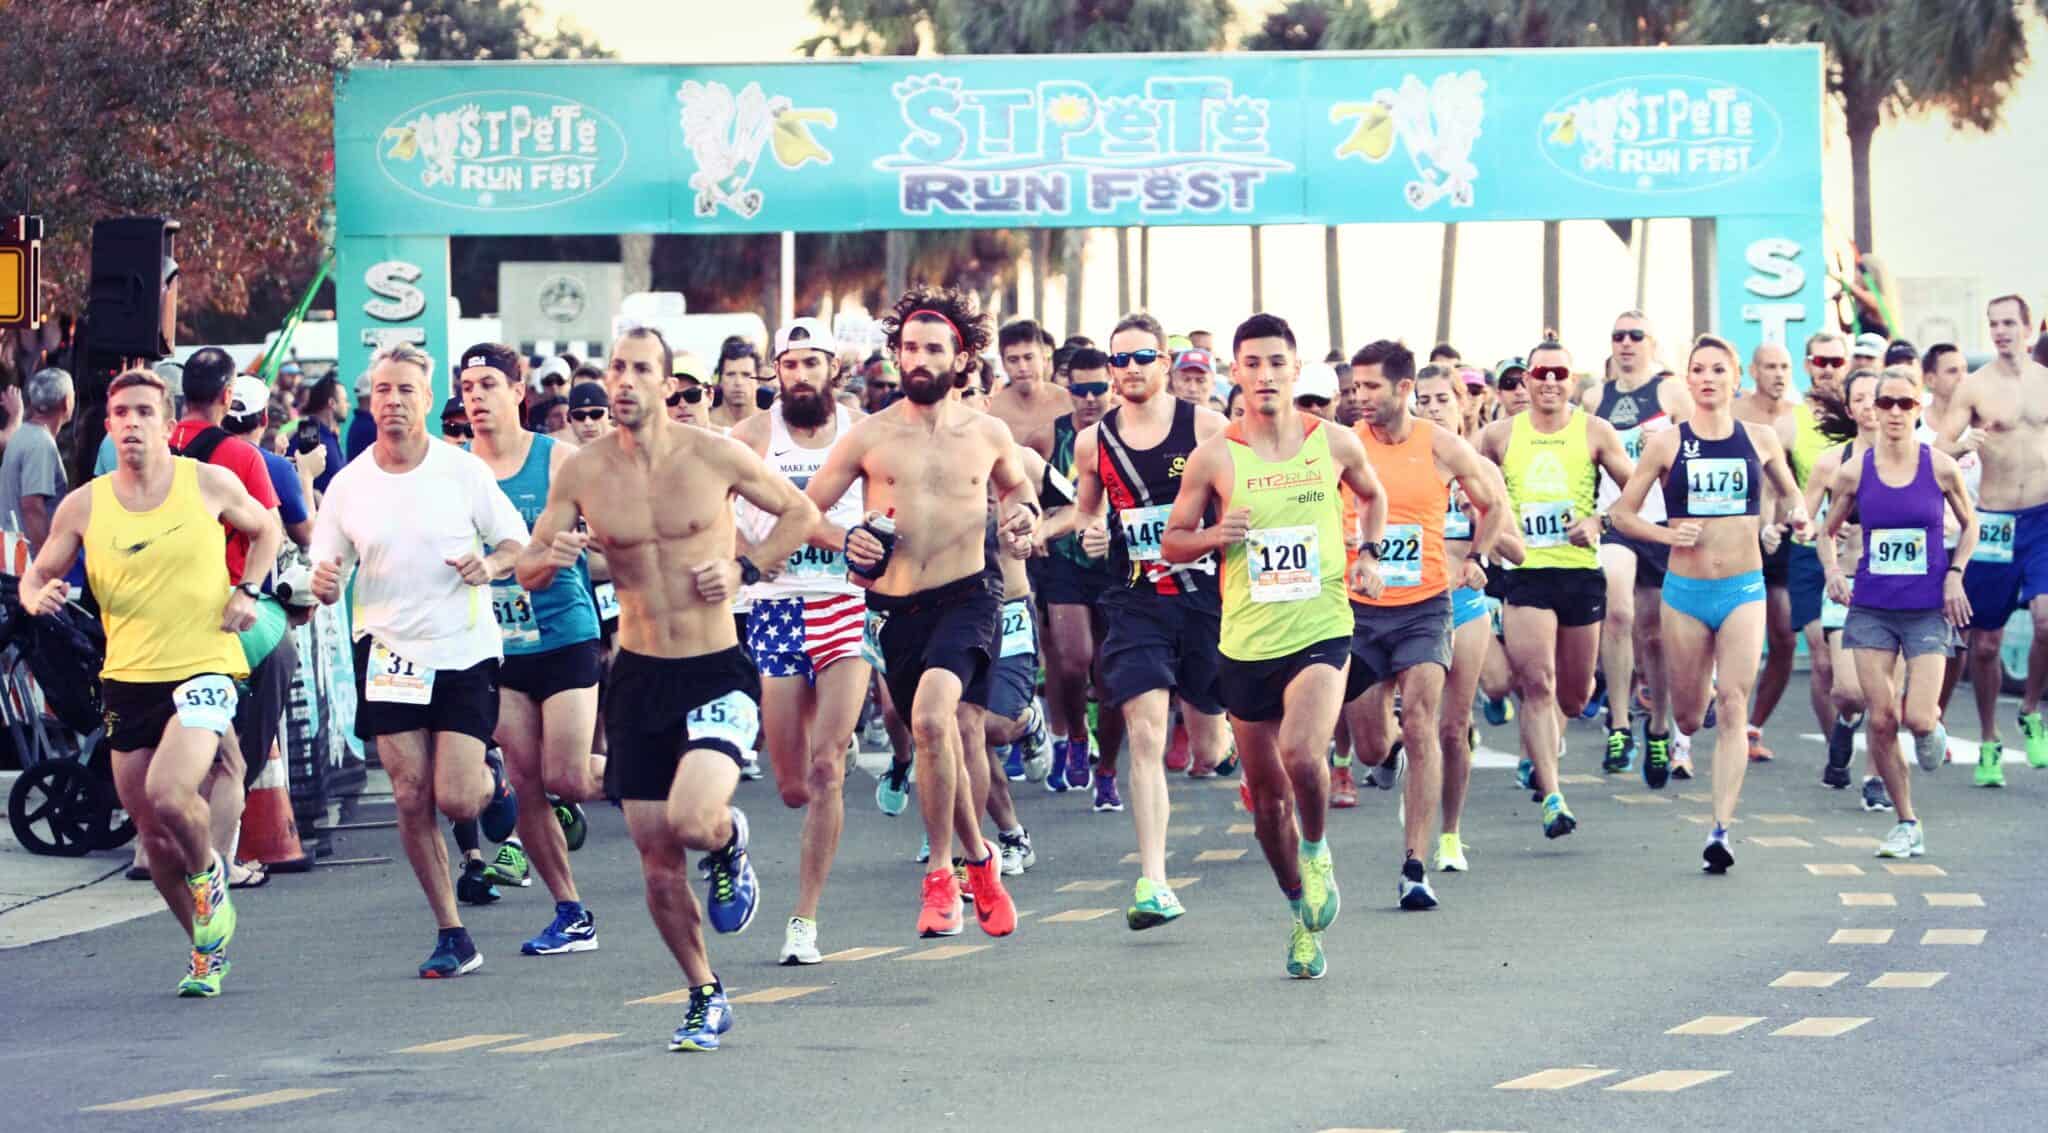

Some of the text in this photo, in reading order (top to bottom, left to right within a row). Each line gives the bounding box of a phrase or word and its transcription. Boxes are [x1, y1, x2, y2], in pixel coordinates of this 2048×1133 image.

[1693, 472, 1744, 493] 1179
[1297, 490, 1325, 503] elite
[1260, 543, 1308, 572] 120
[1879, 542, 1917, 562] 979
[387, 652, 415, 676] 31
[185, 687, 228, 709] 532
